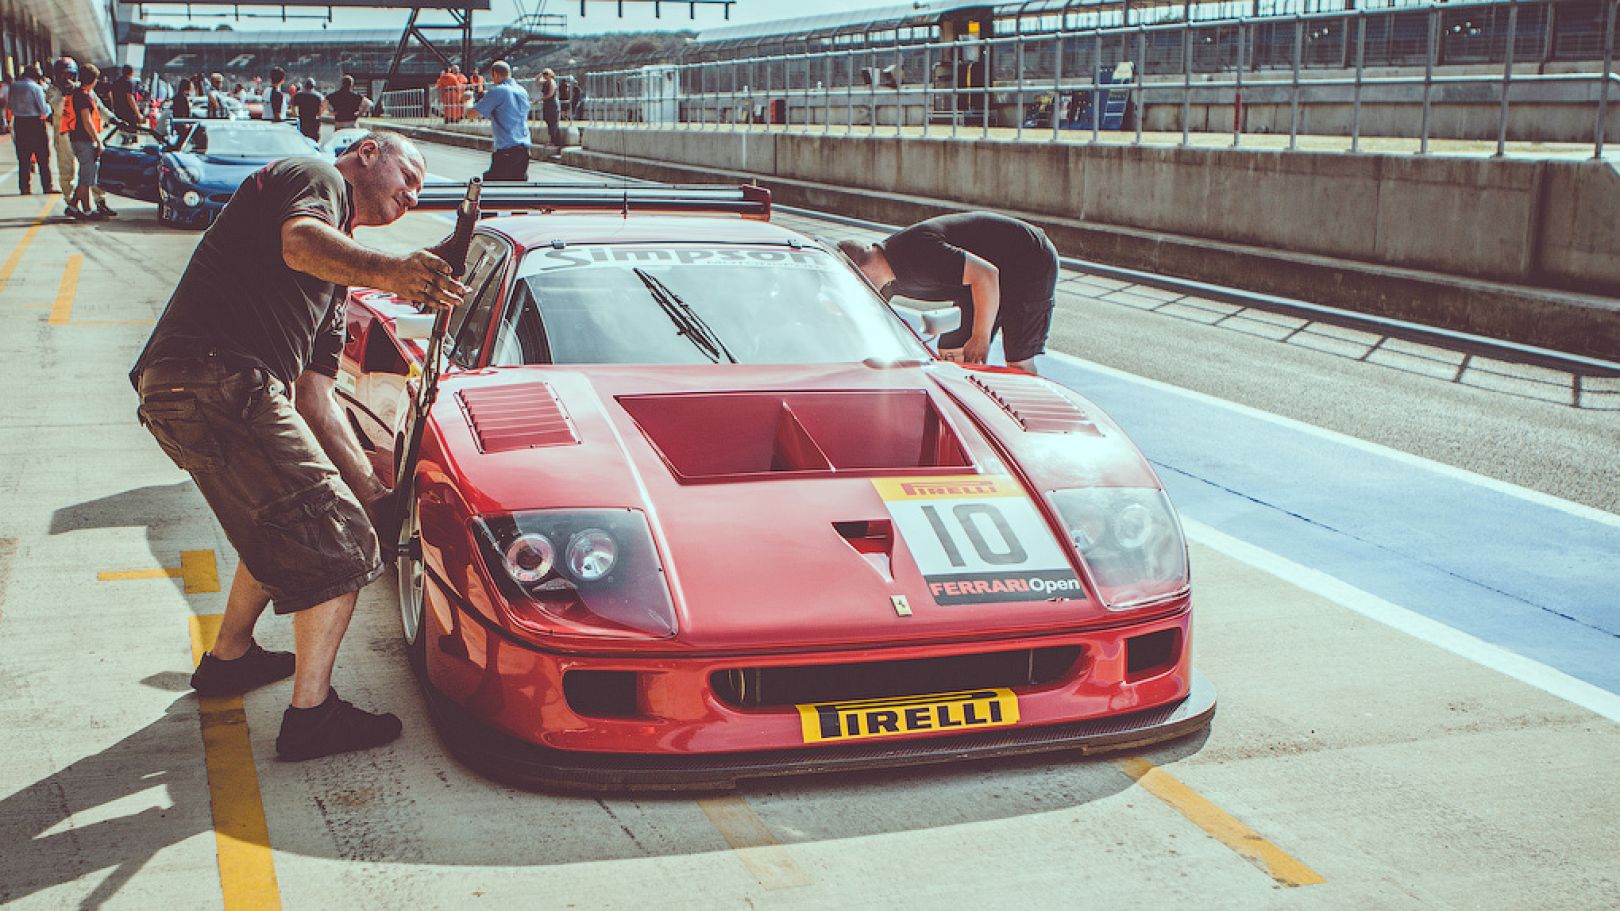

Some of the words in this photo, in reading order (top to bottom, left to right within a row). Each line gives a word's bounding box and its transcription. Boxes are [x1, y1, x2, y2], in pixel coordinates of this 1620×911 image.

[540, 248, 825, 271] Simpson
[901, 480, 998, 496] PIRELLI
[921, 503, 1028, 567] 10
[815, 691, 1002, 738] PIRELLI
